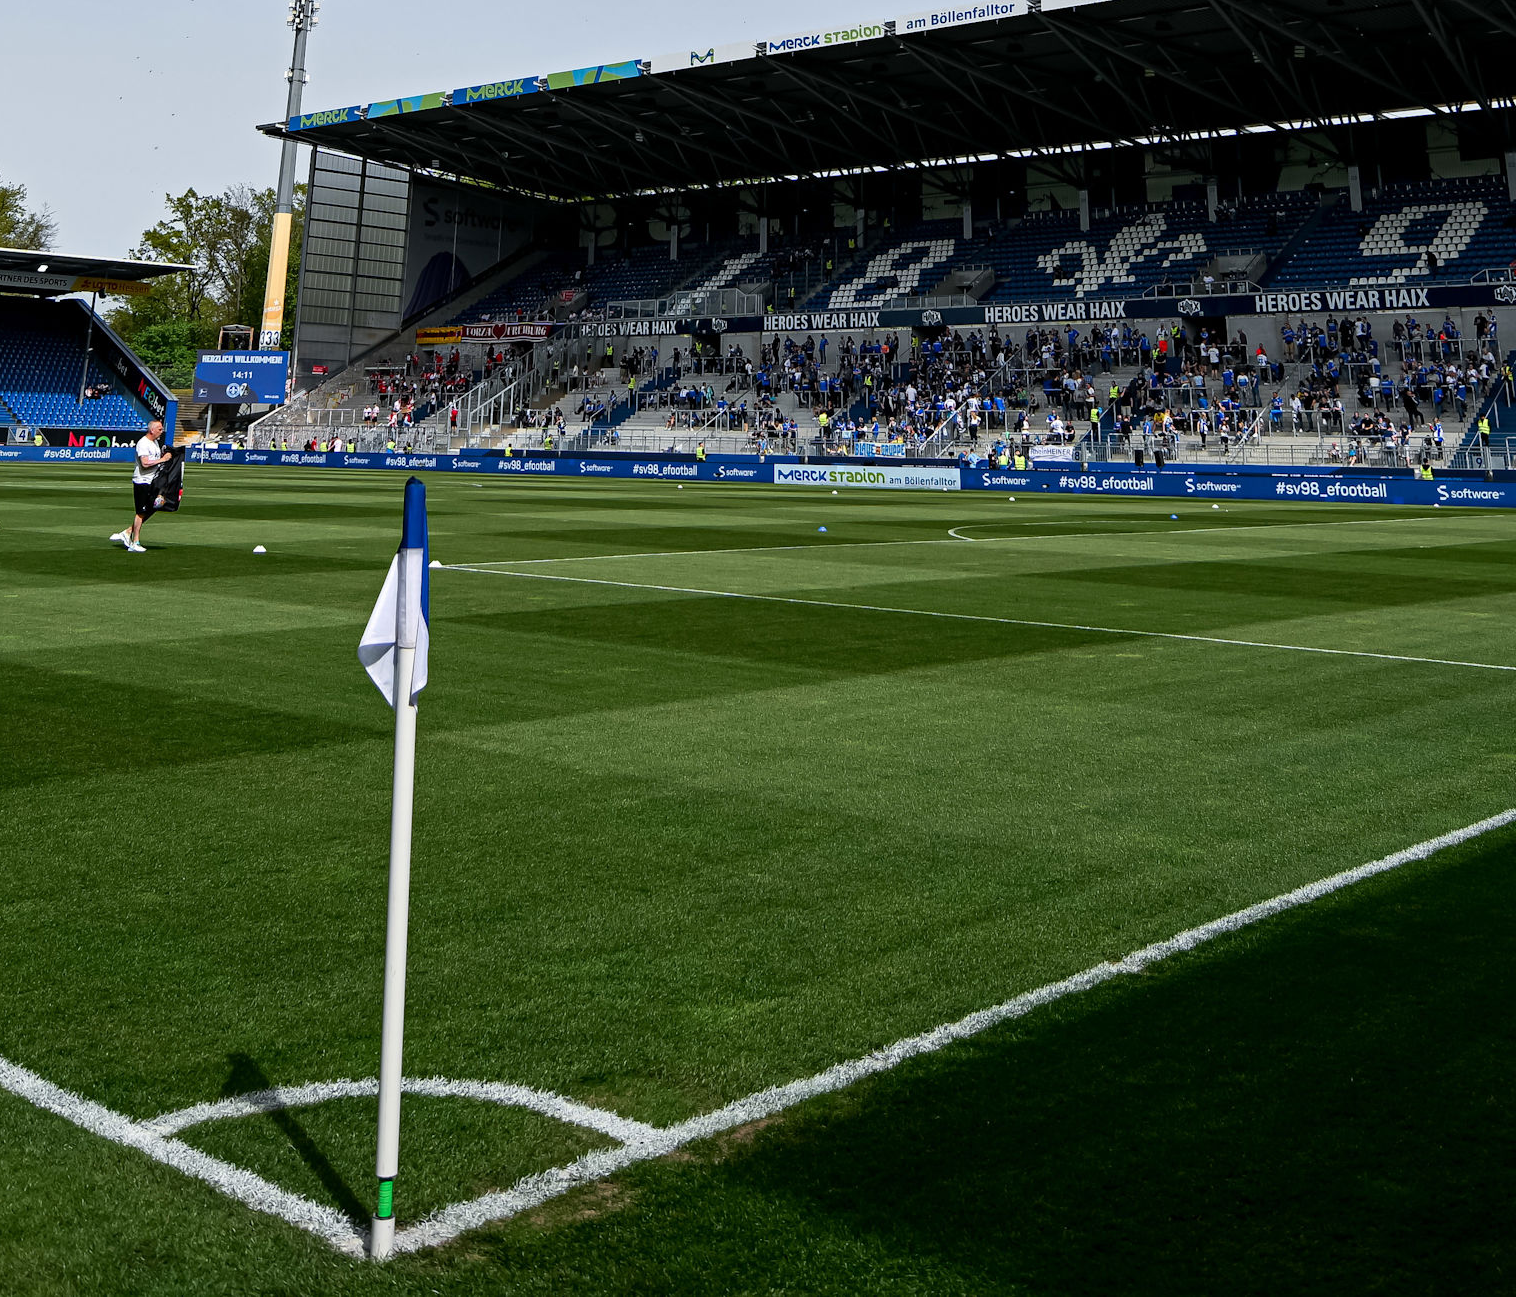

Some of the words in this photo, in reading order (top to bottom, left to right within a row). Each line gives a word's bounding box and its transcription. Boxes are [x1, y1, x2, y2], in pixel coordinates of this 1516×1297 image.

[905, 17, 927, 30] am
[930, 2, 1016, 26] Böllenfalltor
[22, 276, 39, 285] DES
[40, 277, 68, 287] SPORTS
[1255, 291, 1322, 313] HEROES
[1326, 289, 1380, 310] WEAR
[1385, 288, 1430, 308] HAIX
[984, 304, 1039, 323] HEROES
[1040, 302, 1086, 321] WEAR
[1087, 301, 1126, 319] HAIX
[764, 314, 808, 331] HEROES
[811, 312, 847, 329] WEAR
[849, 311, 880, 328] HAIX
[466, 326, 491, 337] FORZA
[580, 323, 617, 337] HEROES
[618, 321, 650, 336] WEAR
[651, 320, 677, 335] HAIX
[202, 354, 233, 363] HERZLICH
[234, 356, 283, 364] WILLKOMMEN!
[232, 371, 253, 379] 14:11
[18, 429, 27, 441] 4
[1475, 457, 1482, 468] 9
[726, 469, 754, 477] software
[904, 475, 957, 487] Böllenfalltor
[992, 477, 1027, 485] software
[1197, 481, 1236, 491] software
[1451, 489, 1498, 499] software
